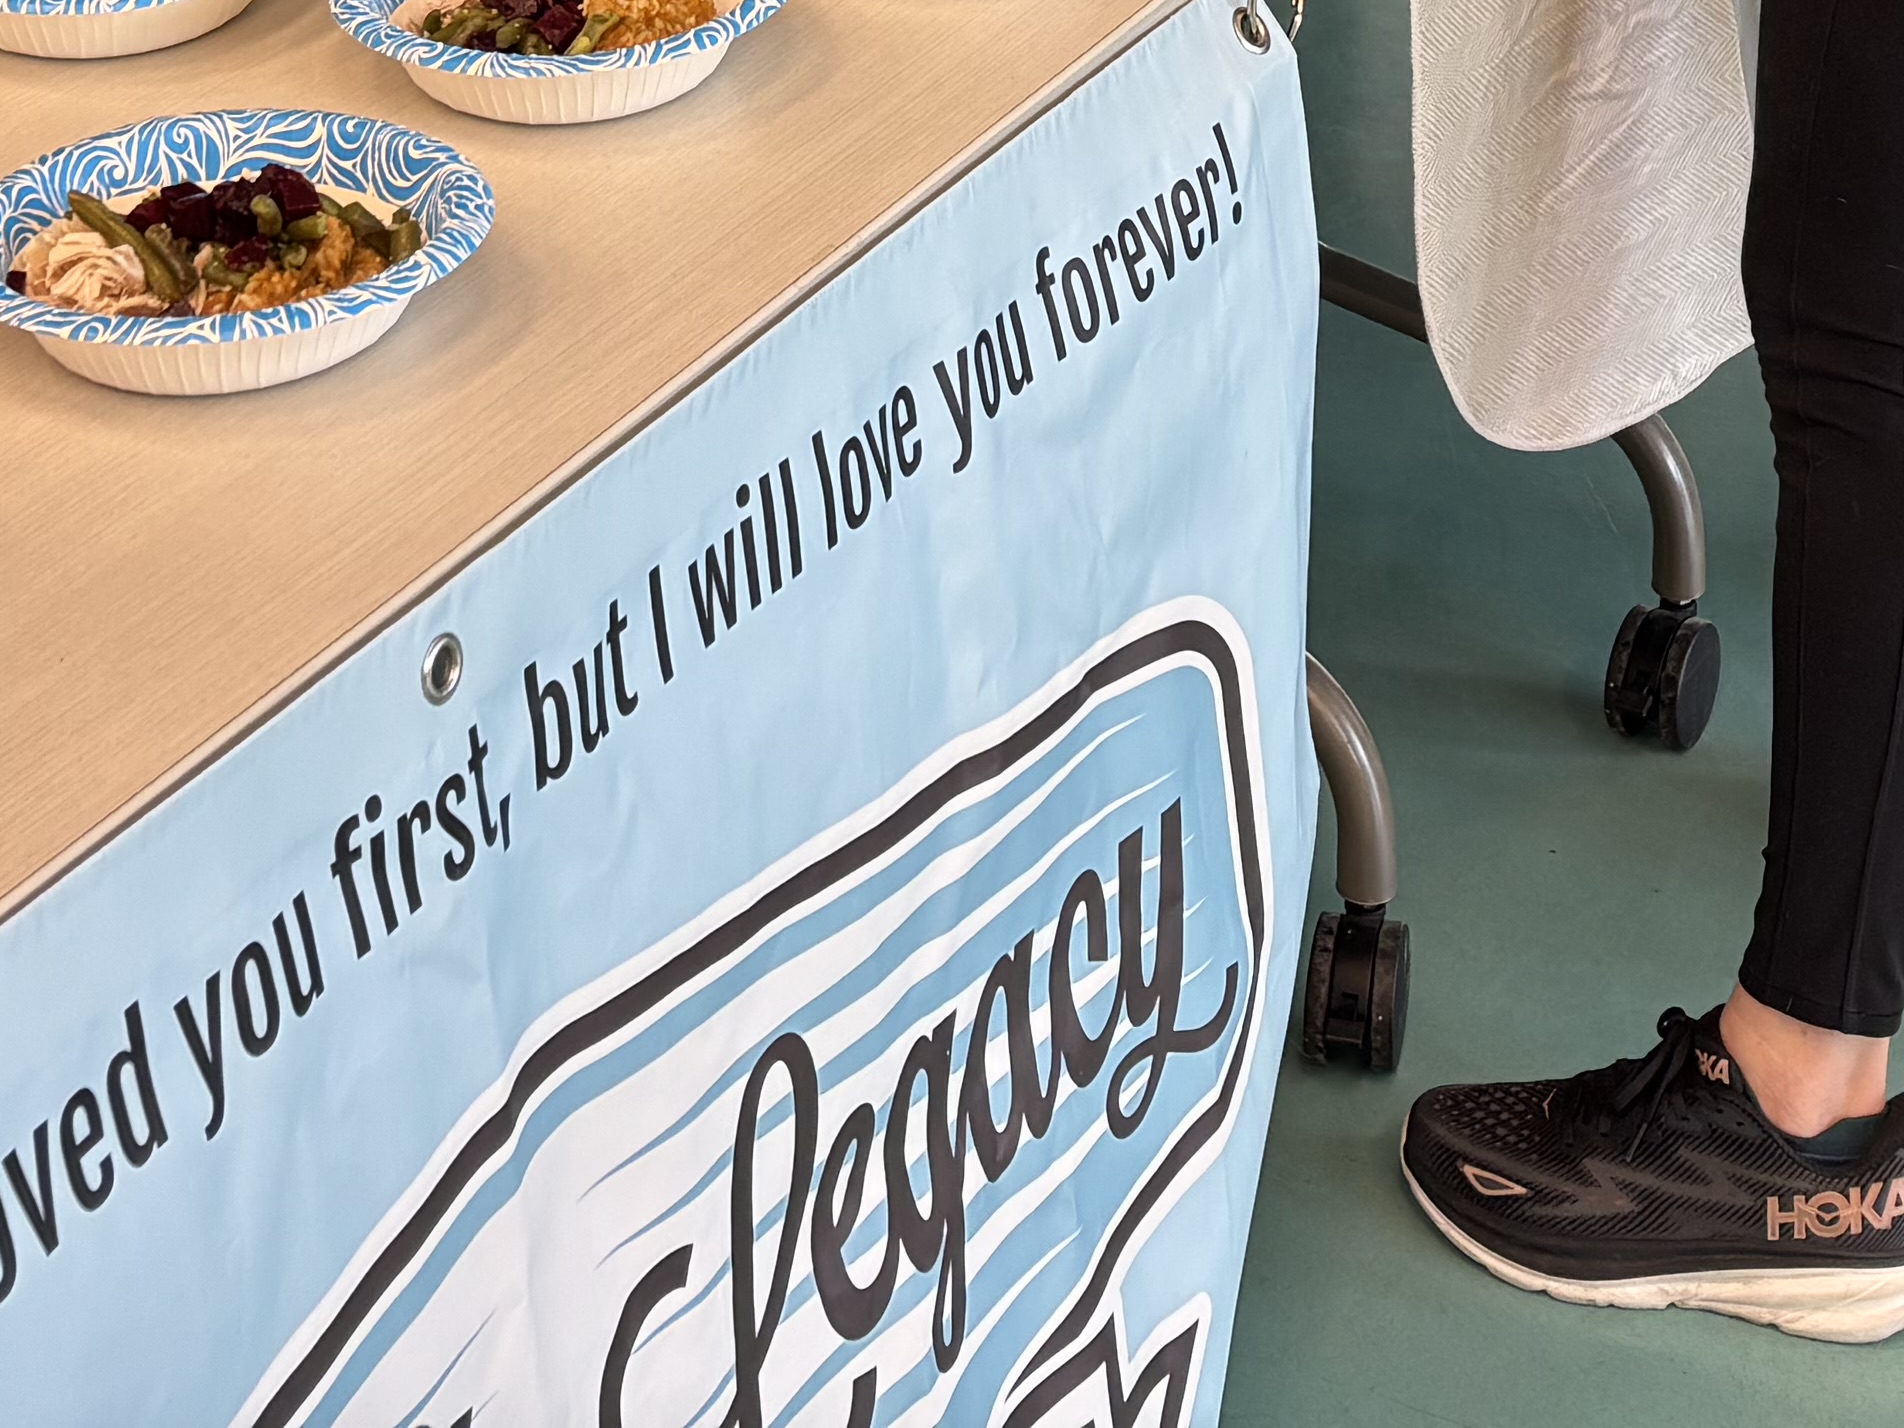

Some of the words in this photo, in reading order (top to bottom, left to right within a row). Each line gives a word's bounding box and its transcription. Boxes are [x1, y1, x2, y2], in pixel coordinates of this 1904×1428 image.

[174, 891, 325, 1141] you
[330, 725, 511, 959] first,
[523, 598, 639, 791] but
[648, 564, 674, 684] I
[688, 458, 803, 649] will
[812, 385, 922, 550] love
[933, 300, 1034, 474] you
[1036, 122, 1242, 362] forever!
[599, 797, 1239, 1428] Legacy
